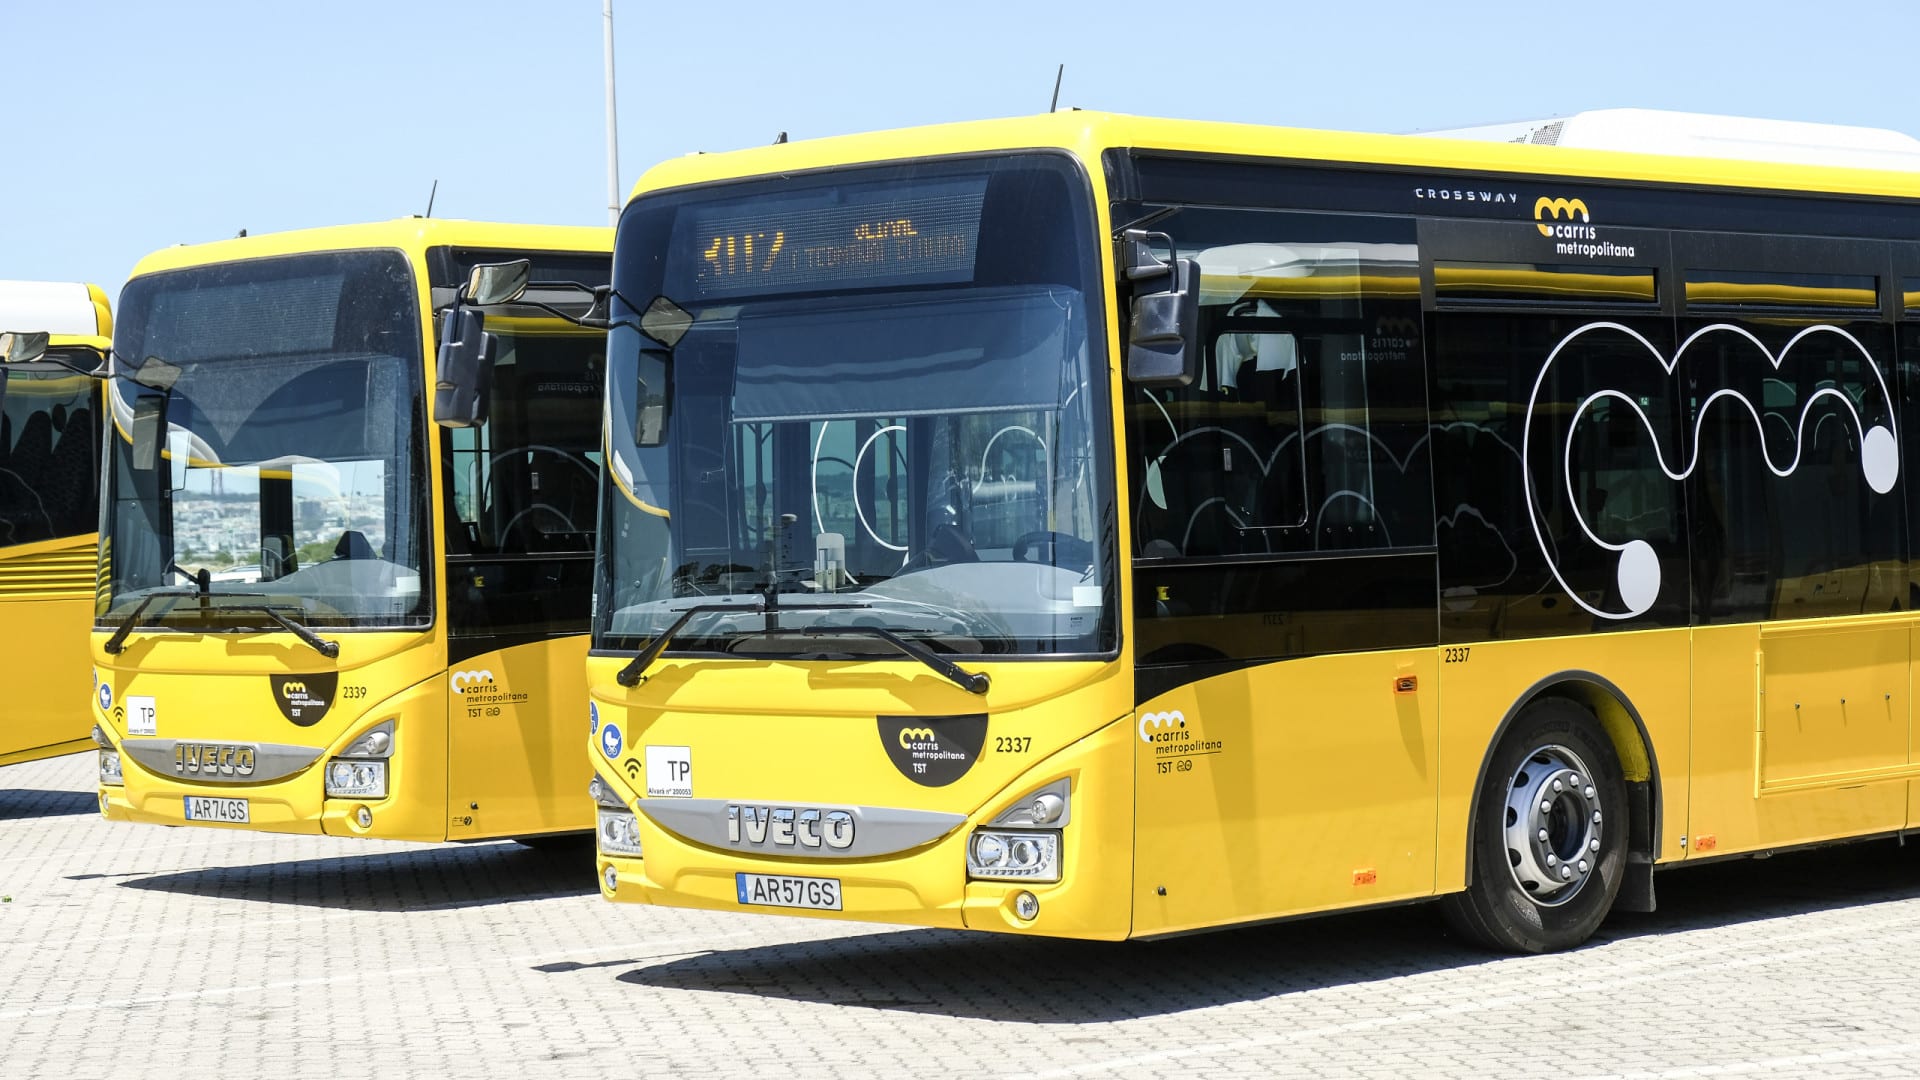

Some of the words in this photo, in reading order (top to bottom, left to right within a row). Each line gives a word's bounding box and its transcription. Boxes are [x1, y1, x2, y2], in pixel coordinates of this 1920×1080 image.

[1415, 188, 1517, 203] CROSSWAY
[1556, 225, 1596, 240] carris
[1556, 241, 1635, 259] metropolitana
[1445, 647, 1470, 663] 2337
[343, 686, 367, 699] 2339
[466, 684, 498, 694] carris
[466, 692, 528, 703] metropolitana
[140, 707, 155, 723] TP
[467, 708, 482, 718] TST
[1156, 730, 1190, 742] carris
[912, 741, 938, 750] carris
[996, 737, 1032, 753] 2337
[1156, 740, 1222, 754] metropolitana
[175, 744, 255, 775] IVECO
[912, 751, 965, 761] metropolitana
[667, 760, 690, 782] TP
[912, 763, 927, 774] TST
[1157, 761, 1172, 774] TST
[727, 805, 856, 849] IVECO
